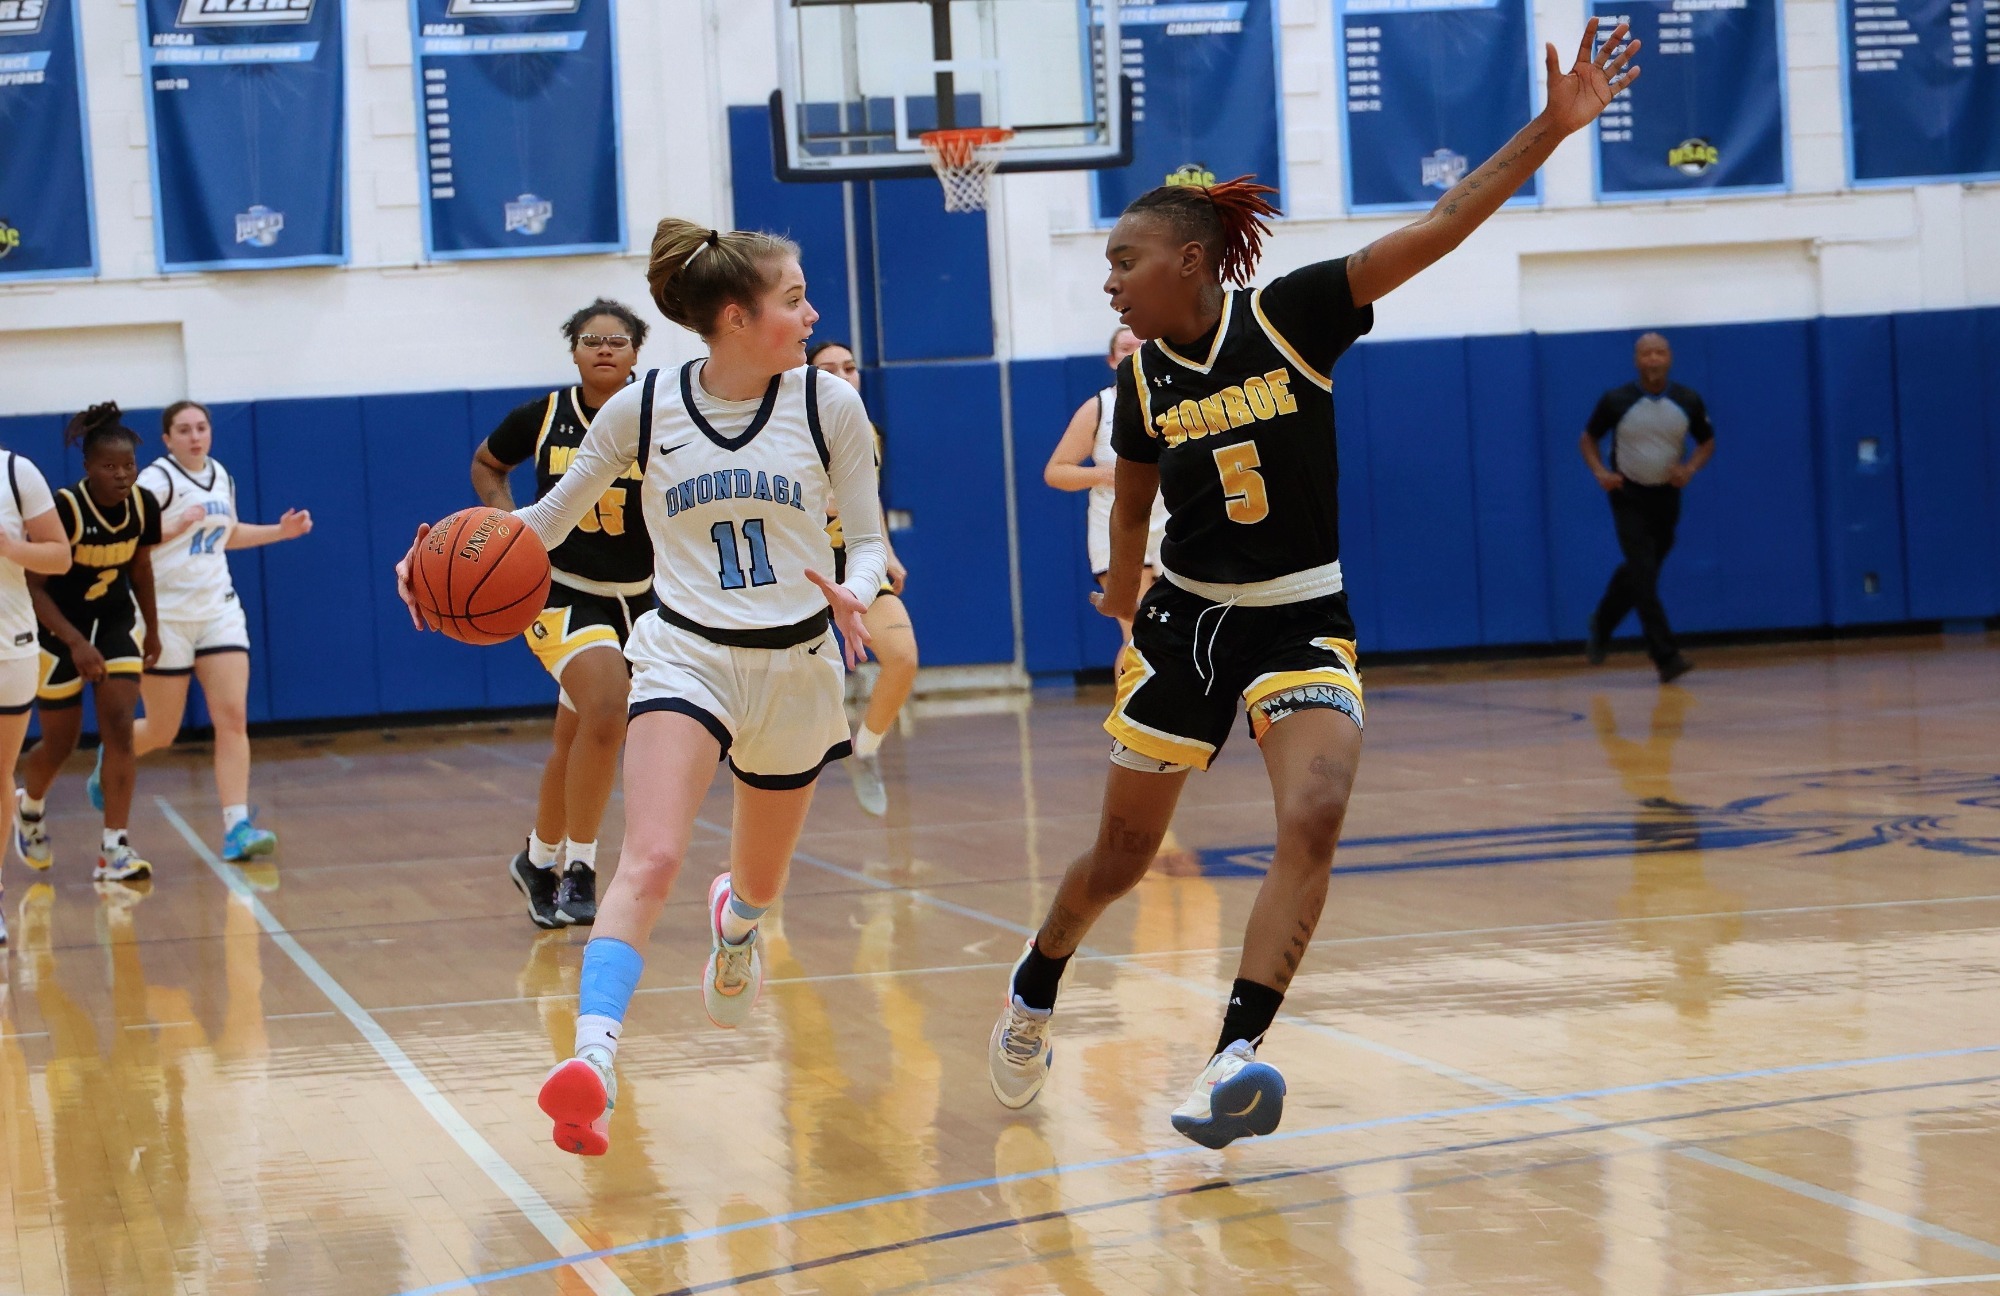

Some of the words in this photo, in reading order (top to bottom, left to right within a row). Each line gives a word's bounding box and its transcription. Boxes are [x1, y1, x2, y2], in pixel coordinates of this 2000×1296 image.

[1155, 367, 1298, 449] MONROE
[665, 468, 806, 518] ONONDAGA
[1212, 439, 1269, 525] 5
[459, 511, 506, 564] PALDING
[710, 518, 777, 590] 11
